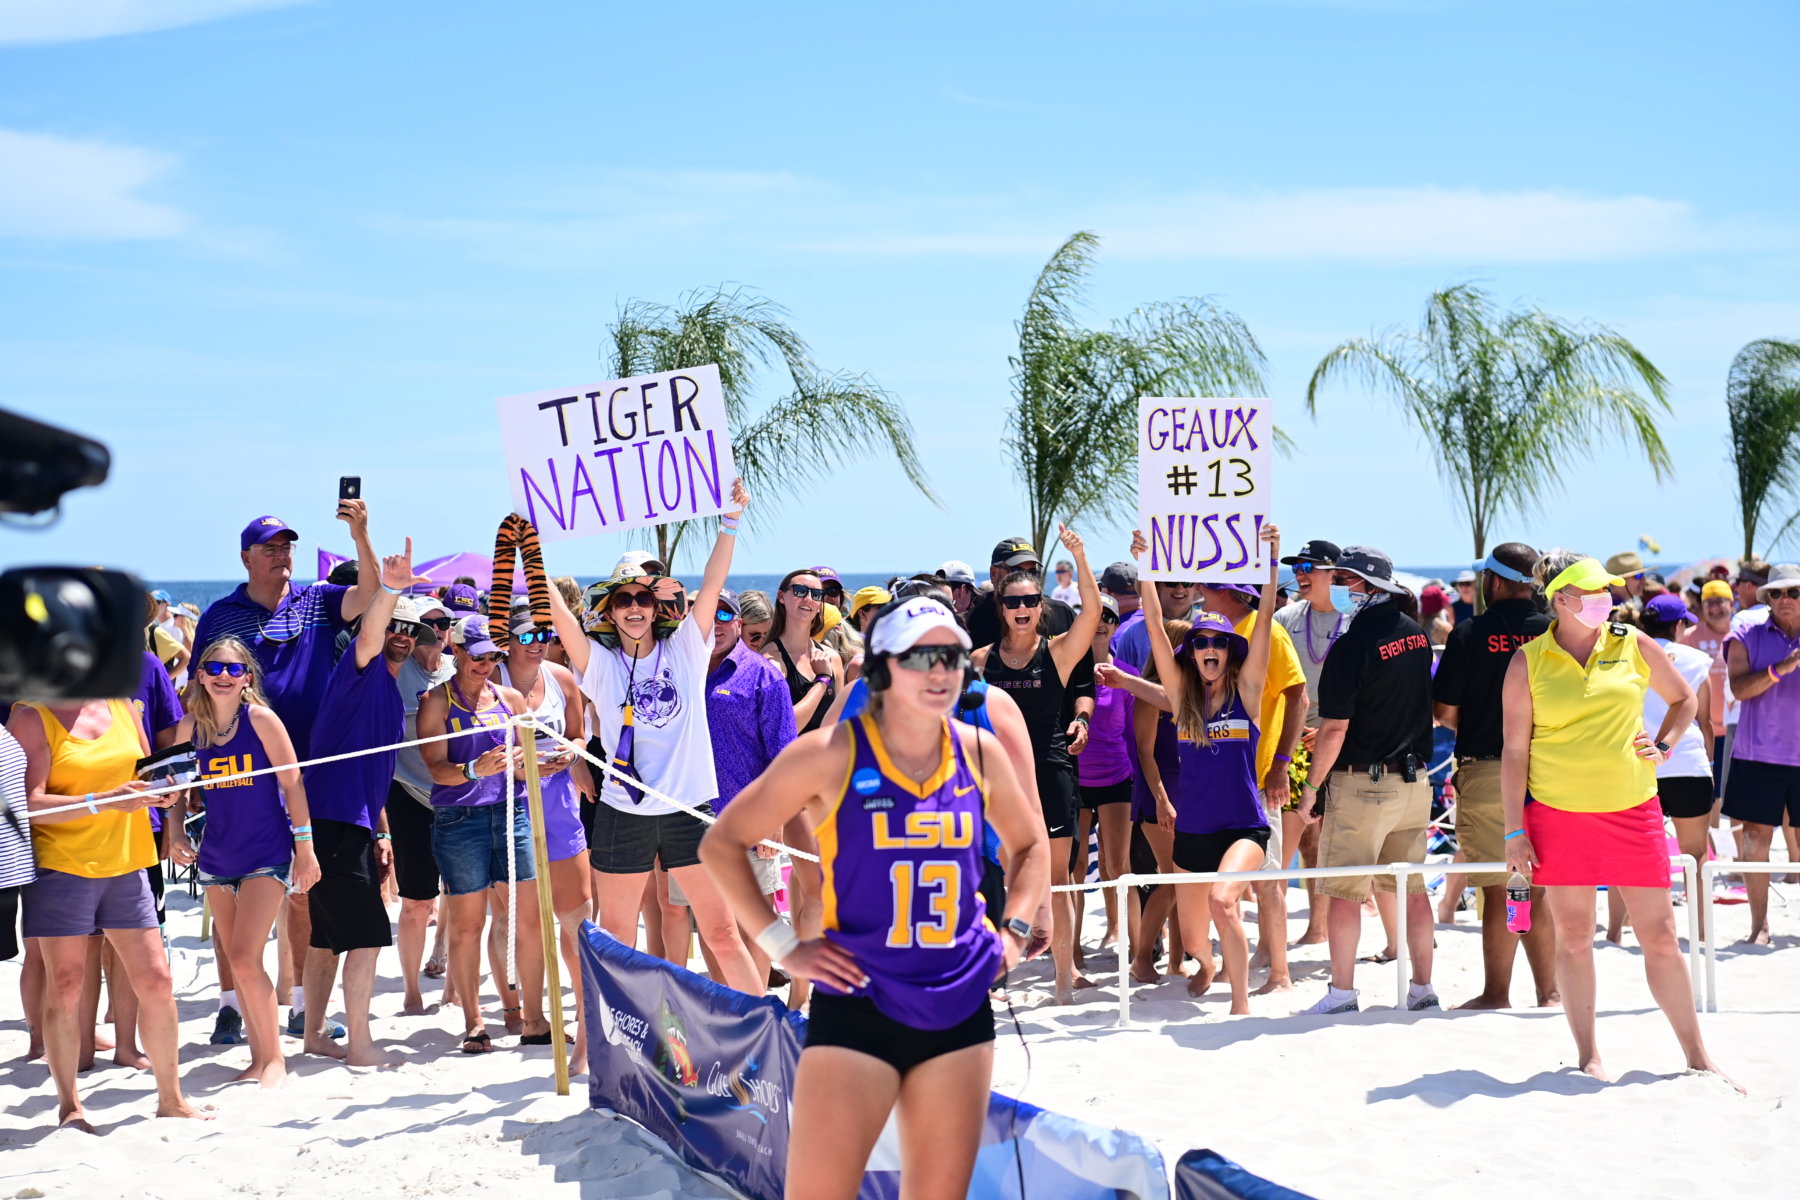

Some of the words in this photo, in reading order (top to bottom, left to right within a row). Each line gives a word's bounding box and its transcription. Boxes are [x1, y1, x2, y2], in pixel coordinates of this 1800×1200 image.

[538, 375, 702, 447] TIGER
[1148, 407, 1259, 452] GEAUX
[520, 429, 722, 535] NATION
[1012, 543, 1035, 552] LSU
[1151, 513, 1264, 572] NUSS!
[907, 606, 944, 618] LSU
[1200, 612, 1224, 625] LSU
[1378, 637, 1406, 661] EVENT
[872, 811, 974, 850] LSU
[886, 860, 962, 949] 13
[615, 1010, 644, 1036] SHORES
